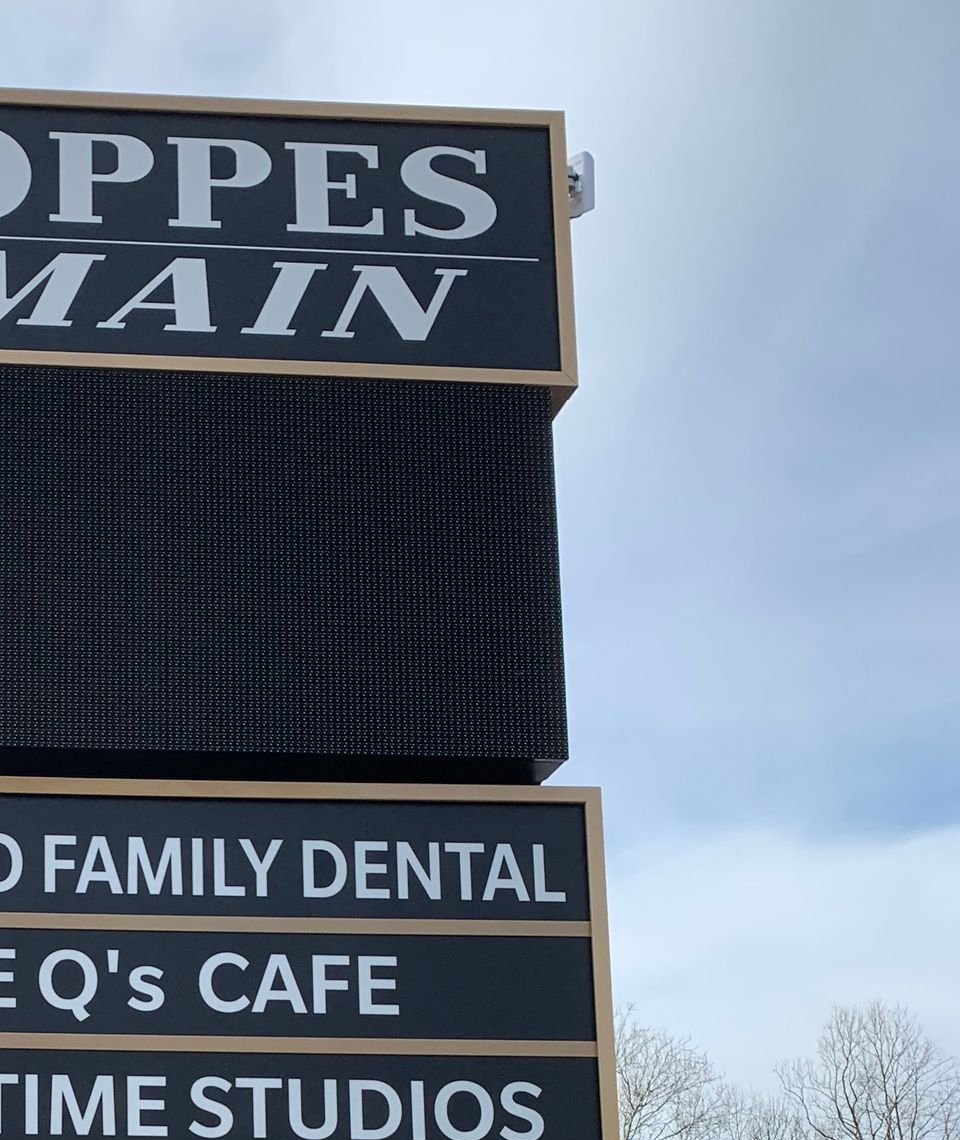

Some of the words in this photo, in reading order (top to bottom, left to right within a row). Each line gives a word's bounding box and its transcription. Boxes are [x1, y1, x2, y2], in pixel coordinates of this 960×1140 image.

[44, 834, 284, 897] FAMILY
[302, 839, 566, 903] DENTAL
[38, 948, 166, 1022] Q's
[198, 952, 400, 1015] CAFE
